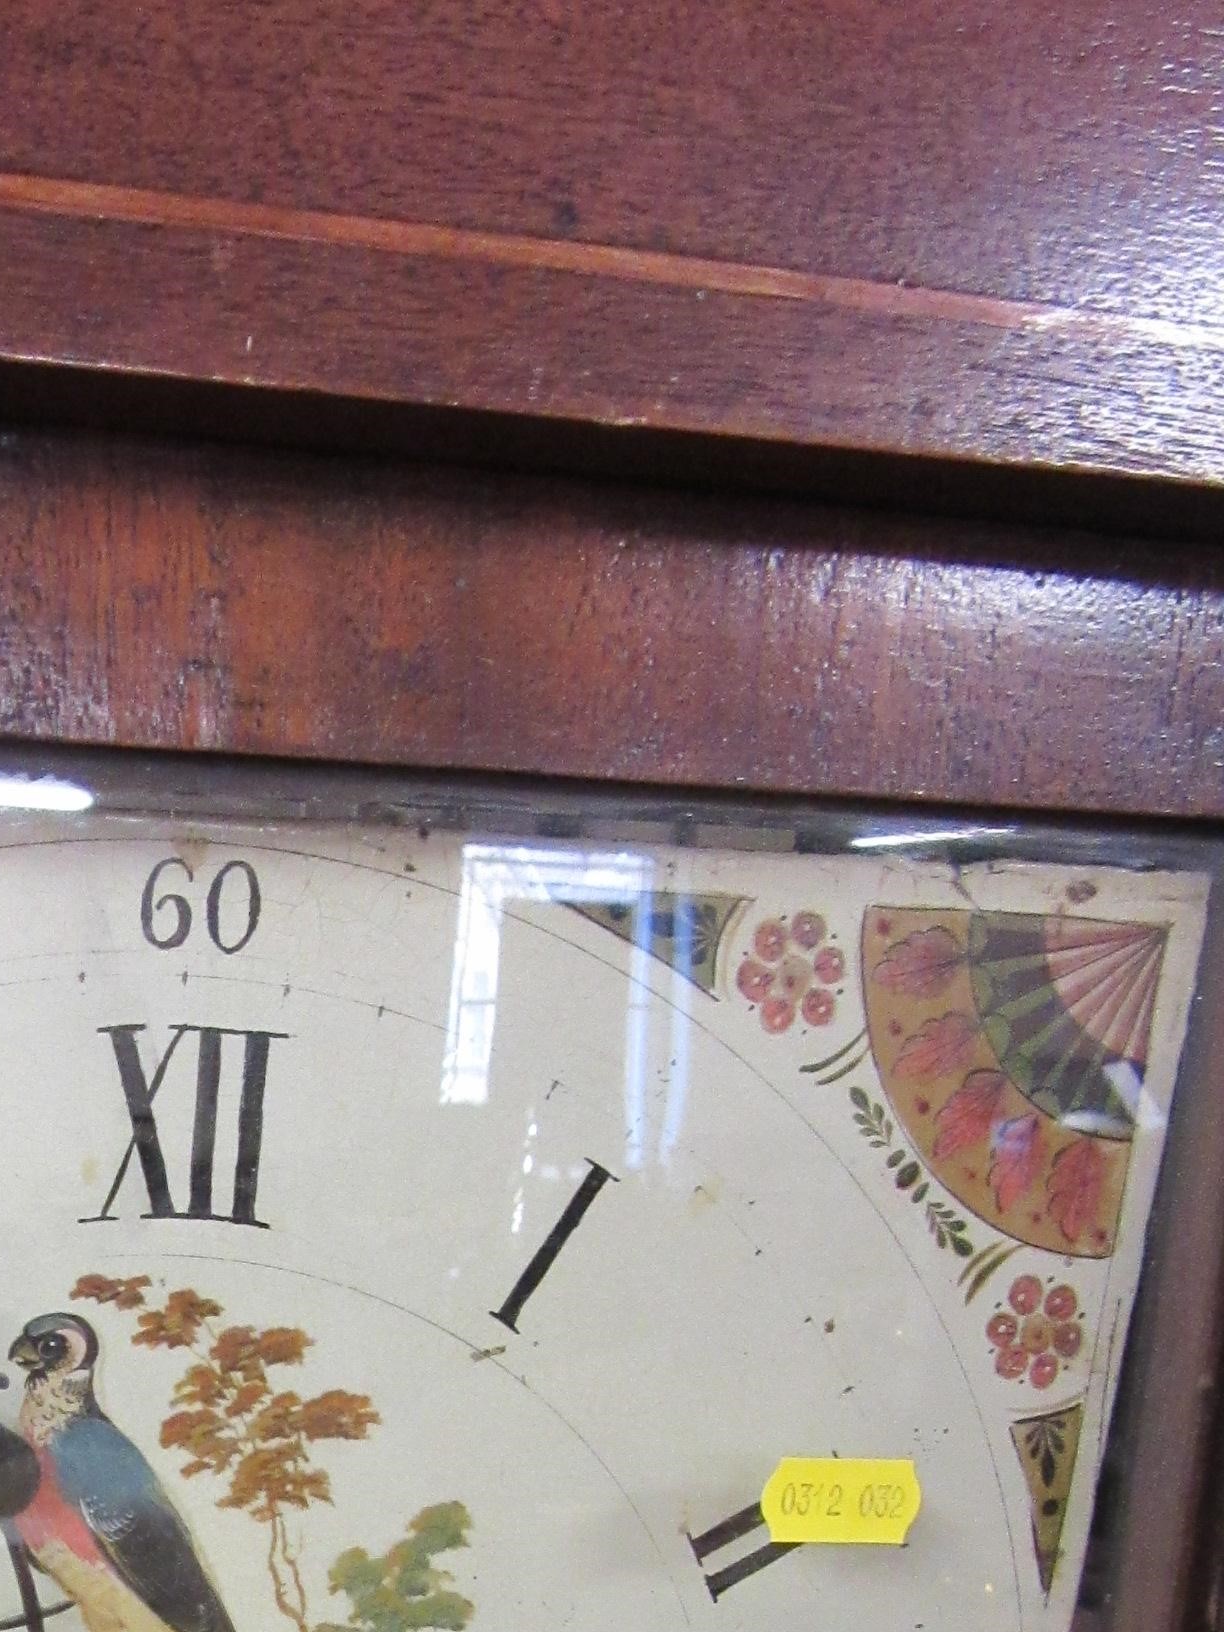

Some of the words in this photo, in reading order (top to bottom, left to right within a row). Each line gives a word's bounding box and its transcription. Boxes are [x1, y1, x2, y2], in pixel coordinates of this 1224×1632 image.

[139, 857, 262, 955] 60
[76, 1022, 291, 1232] XII
[488, 1156, 620, 1334] I
[858, 1483, 906, 1519] 032
